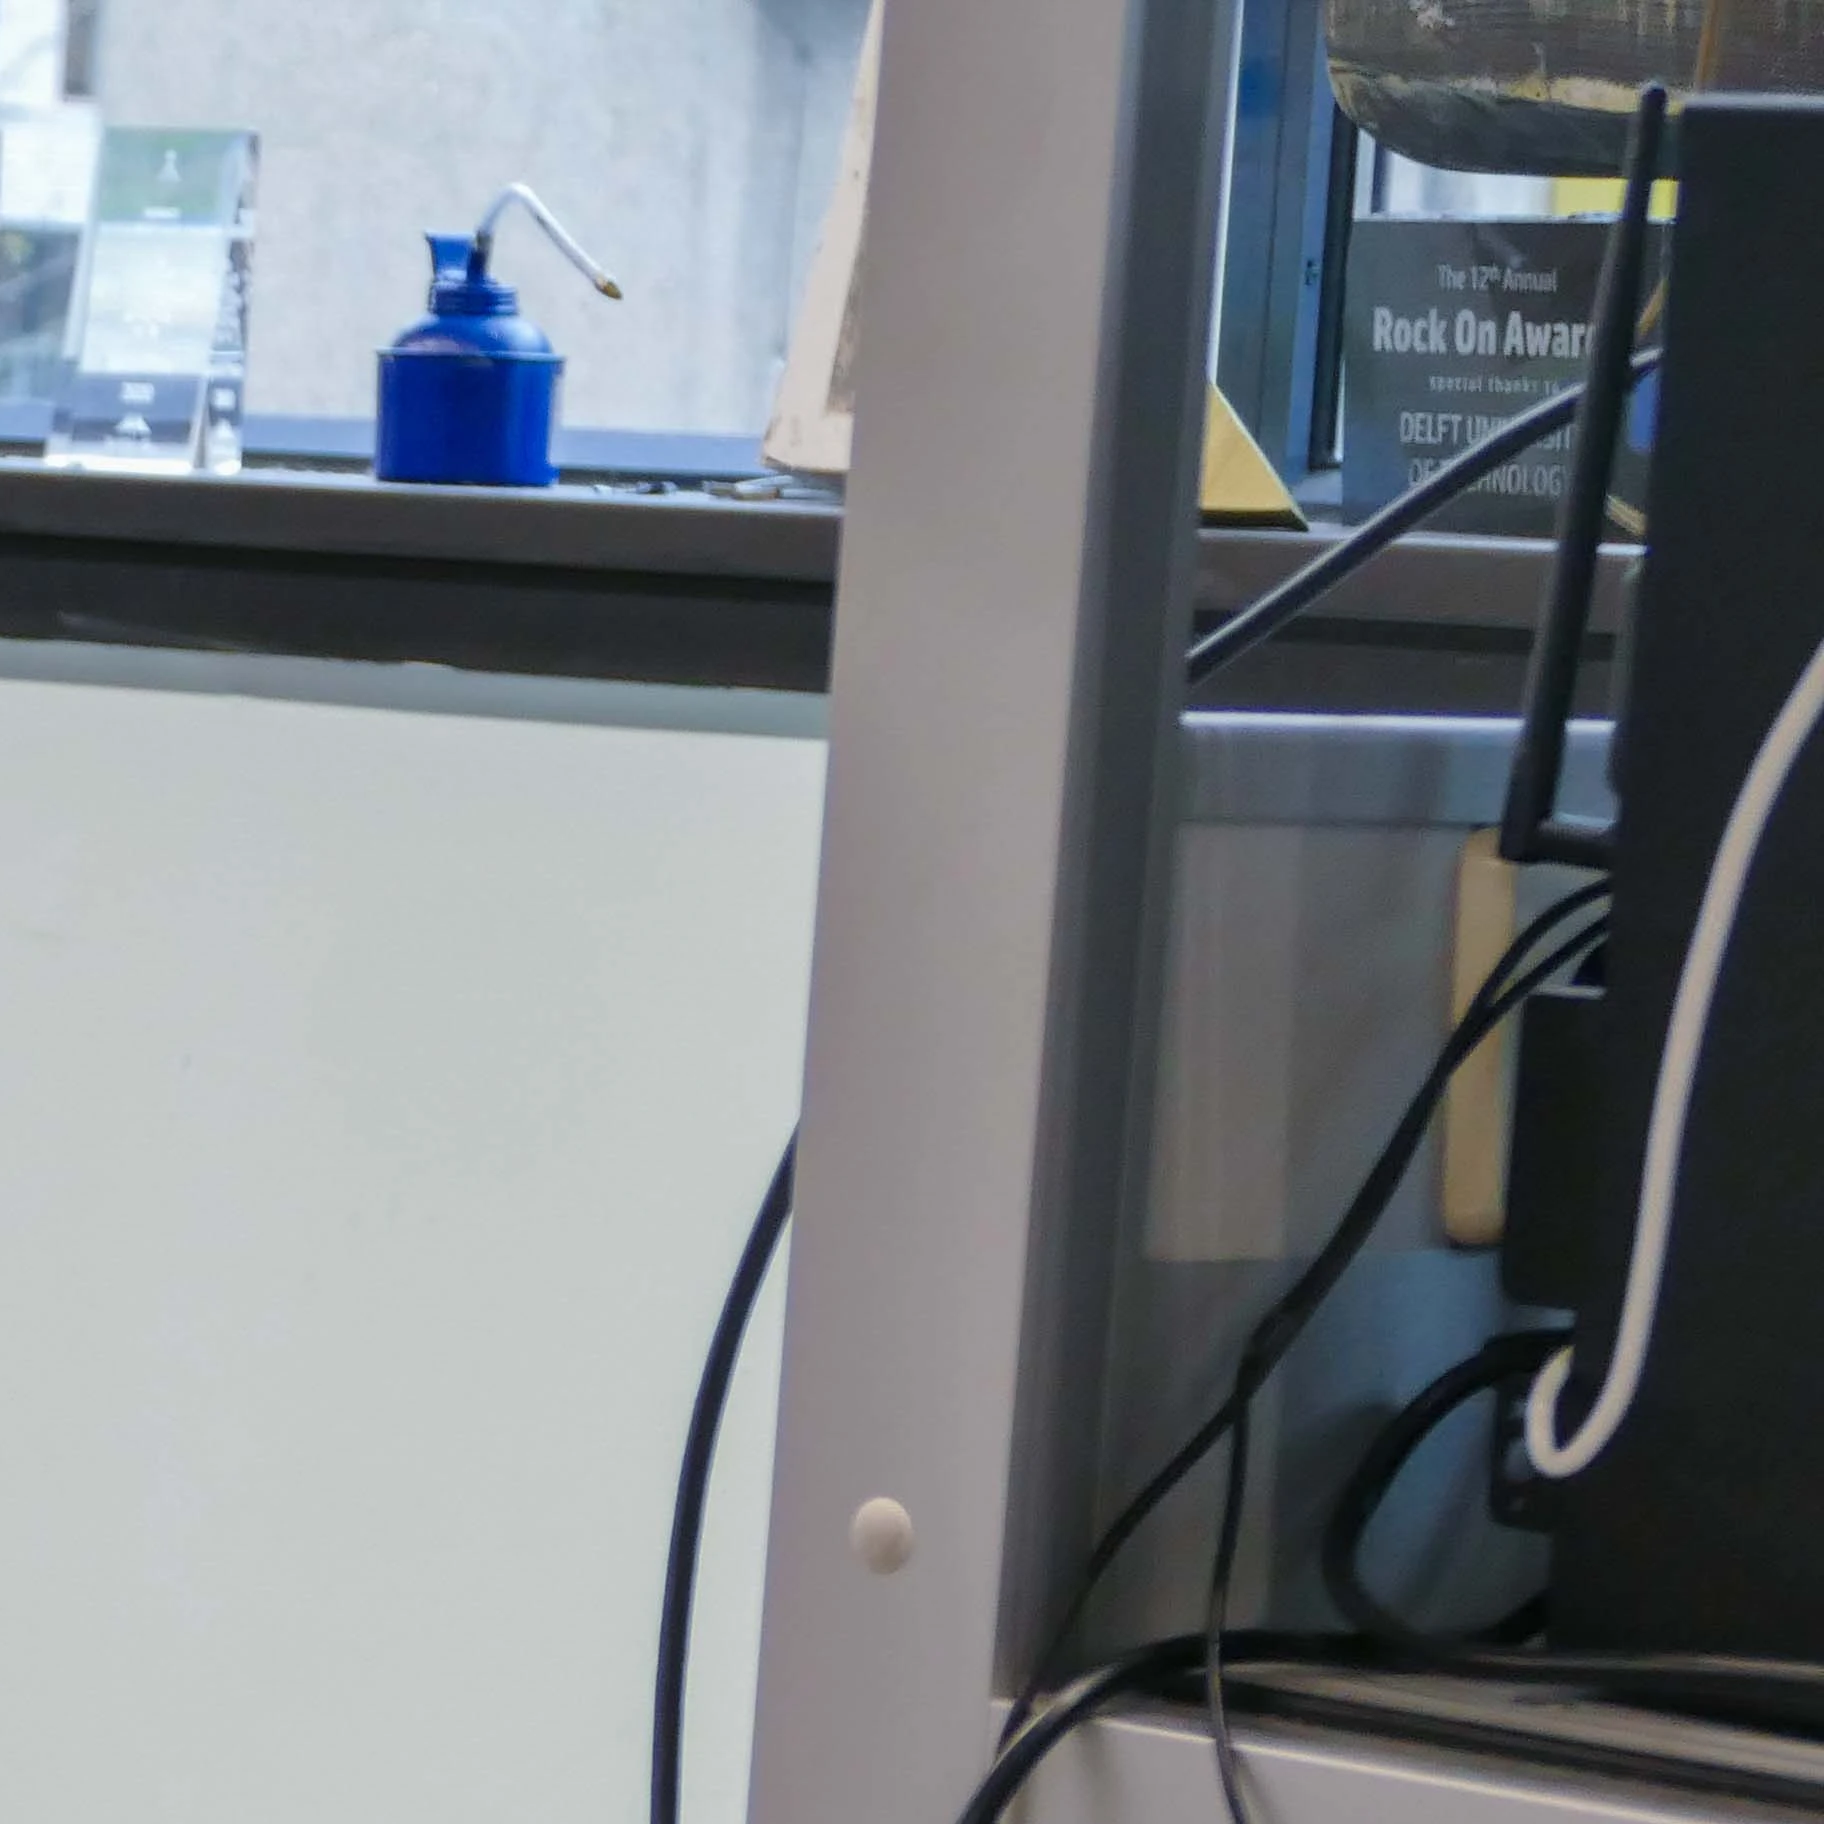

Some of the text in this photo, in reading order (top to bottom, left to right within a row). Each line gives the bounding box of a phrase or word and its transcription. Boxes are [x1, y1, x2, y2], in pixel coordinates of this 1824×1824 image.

[1438, 263, 1467, 290] The
[1503, 267, 1558, 293] Annual
[1372, 306, 1448, 354] Rock
[1455, 308, 1497, 357] On
[1399, 411, 1463, 445] DELFT
